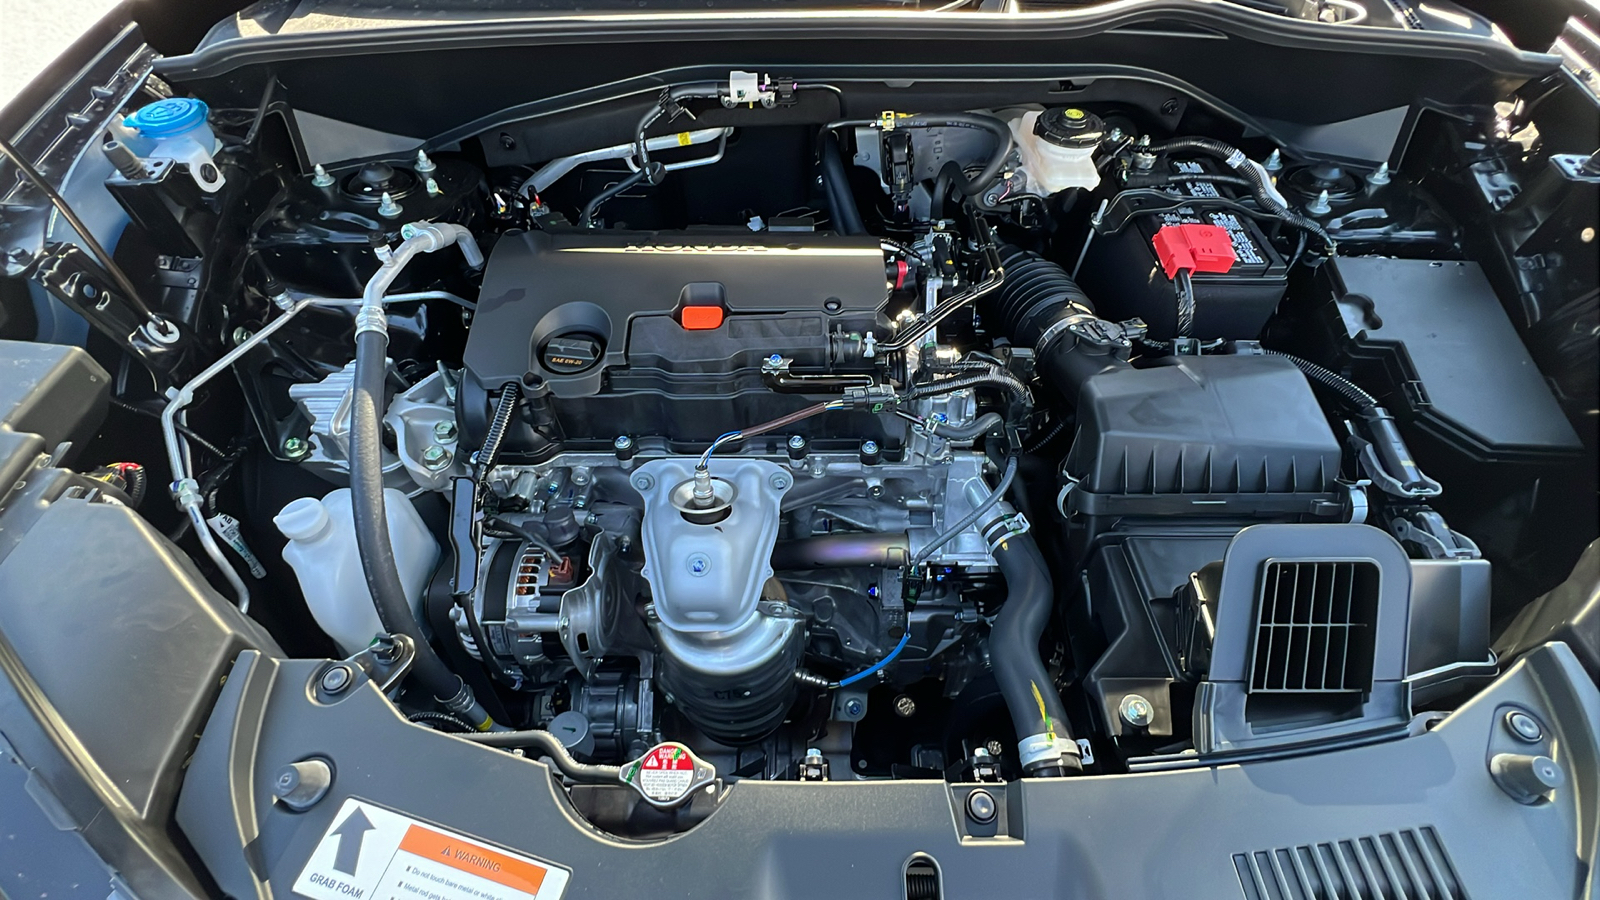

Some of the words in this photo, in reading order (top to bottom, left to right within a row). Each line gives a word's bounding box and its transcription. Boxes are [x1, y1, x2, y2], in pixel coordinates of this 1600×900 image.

[454, 849, 501, 872] WARNING
[309, 872, 337, 889] GRAB
[335, 881, 364, 899] FOAM
[403, 882, 420, 893] Metal
[411, 867, 421, 875] Do
[420, 871, 430, 880] not
[430, 873, 445, 884] touch
[445, 879, 458, 889] bare
[457, 884, 474, 894] metal
